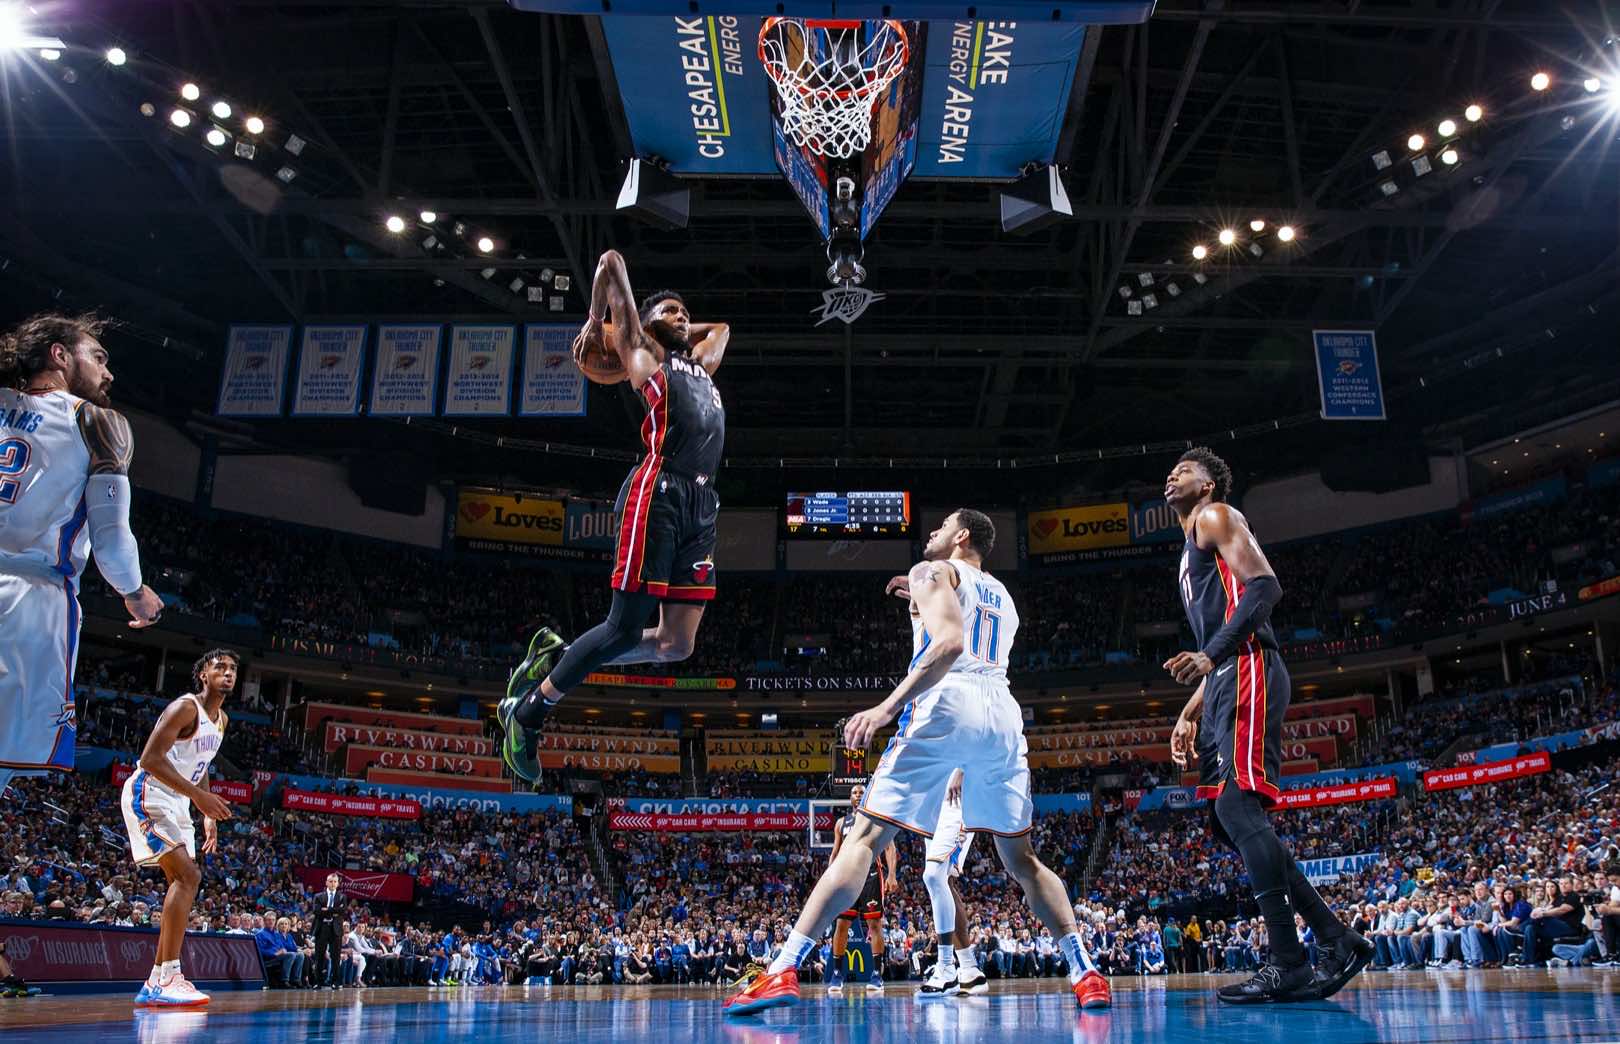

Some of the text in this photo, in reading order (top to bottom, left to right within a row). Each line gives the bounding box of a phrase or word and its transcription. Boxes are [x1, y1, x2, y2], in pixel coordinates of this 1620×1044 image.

[719, 16, 743, 76] ENERG
[675, 16, 725, 158] CHESAPEAK
[938, 21, 974, 163] NERGY ARENA
[1508, 596, 1553, 617] JUNE
[1555, 592, 1567, 604] 4
[969, 603, 1001, 665] 17
[746, 677, 813, 690] TICKETS
[817, 677, 840, 690] ON
[845, 677, 883, 690] SALE
[333, 726, 488, 756] RIVERWIND
[1042, 731, 1157, 750] RIVERWIND
[715, 741, 831, 754] RIVERWIND
[380, 751, 473, 772] CASINO
[563, 755, 641, 769] CASINO
[735, 759, 810, 770] CASINO
[256, 772, 271, 781] 119
[228, 786, 248, 797] TRAVEL
[1076, 793, 1090, 801] 101
[1169, 793, 1187, 801] FOX
[345, 801, 376, 811] INSURANCE
[396, 804, 415, 813] TRAVEL
[608, 798, 624, 807] 120
[757, 803, 801, 815] CITY
[672, 818, 683, 826] CAR
[683, 818, 697, 826] CARE
[717, 818, 747, 826] INSURANCE
[769, 818, 788, 826] TRAVEL
[42, 941, 110, 965] INSURANCE
